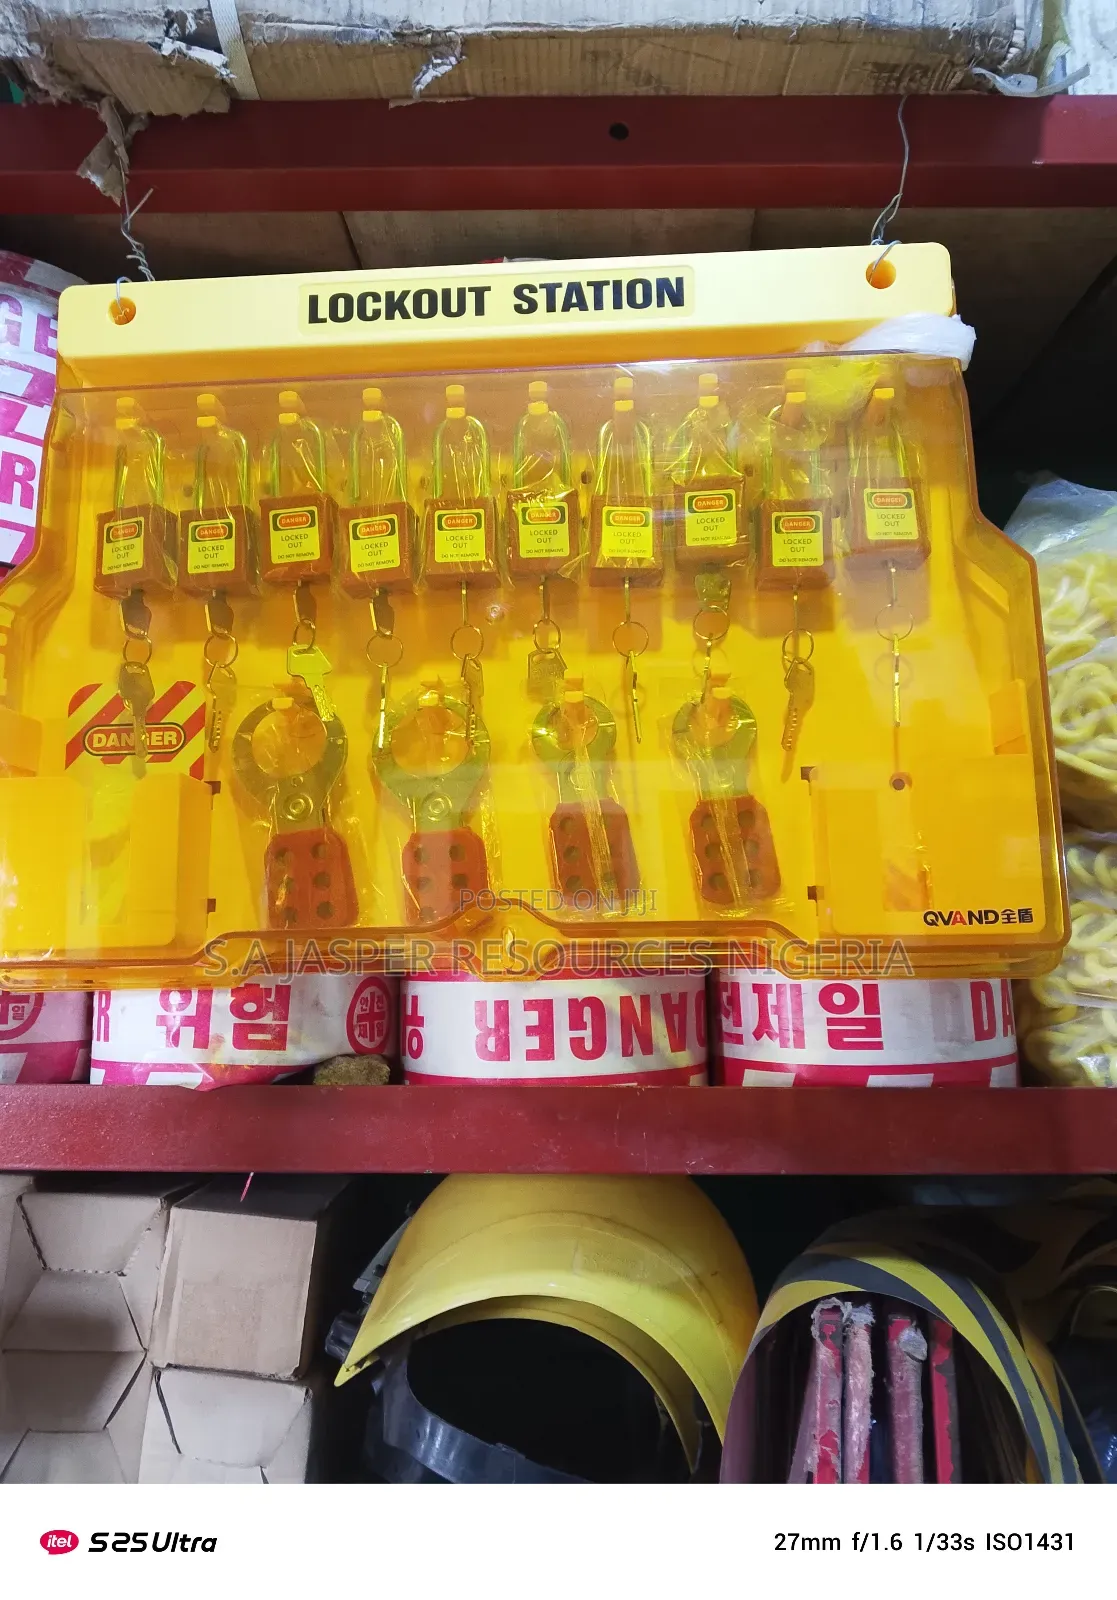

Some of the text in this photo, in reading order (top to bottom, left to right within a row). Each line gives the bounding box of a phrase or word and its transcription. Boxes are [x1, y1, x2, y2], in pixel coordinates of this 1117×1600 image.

[308, 276, 685, 324] LOCKOUT STATION
[361, 525, 387, 533] DANGER
[281, 533, 308, 541] LOCKED
[111, 544, 135, 553] LOCKED
[361, 542, 388, 550] LOCKED
[92, 731, 177, 747] DANER
[923, 909, 1000, 927] QVAND
[156, 983, 291, 1051] 위험
